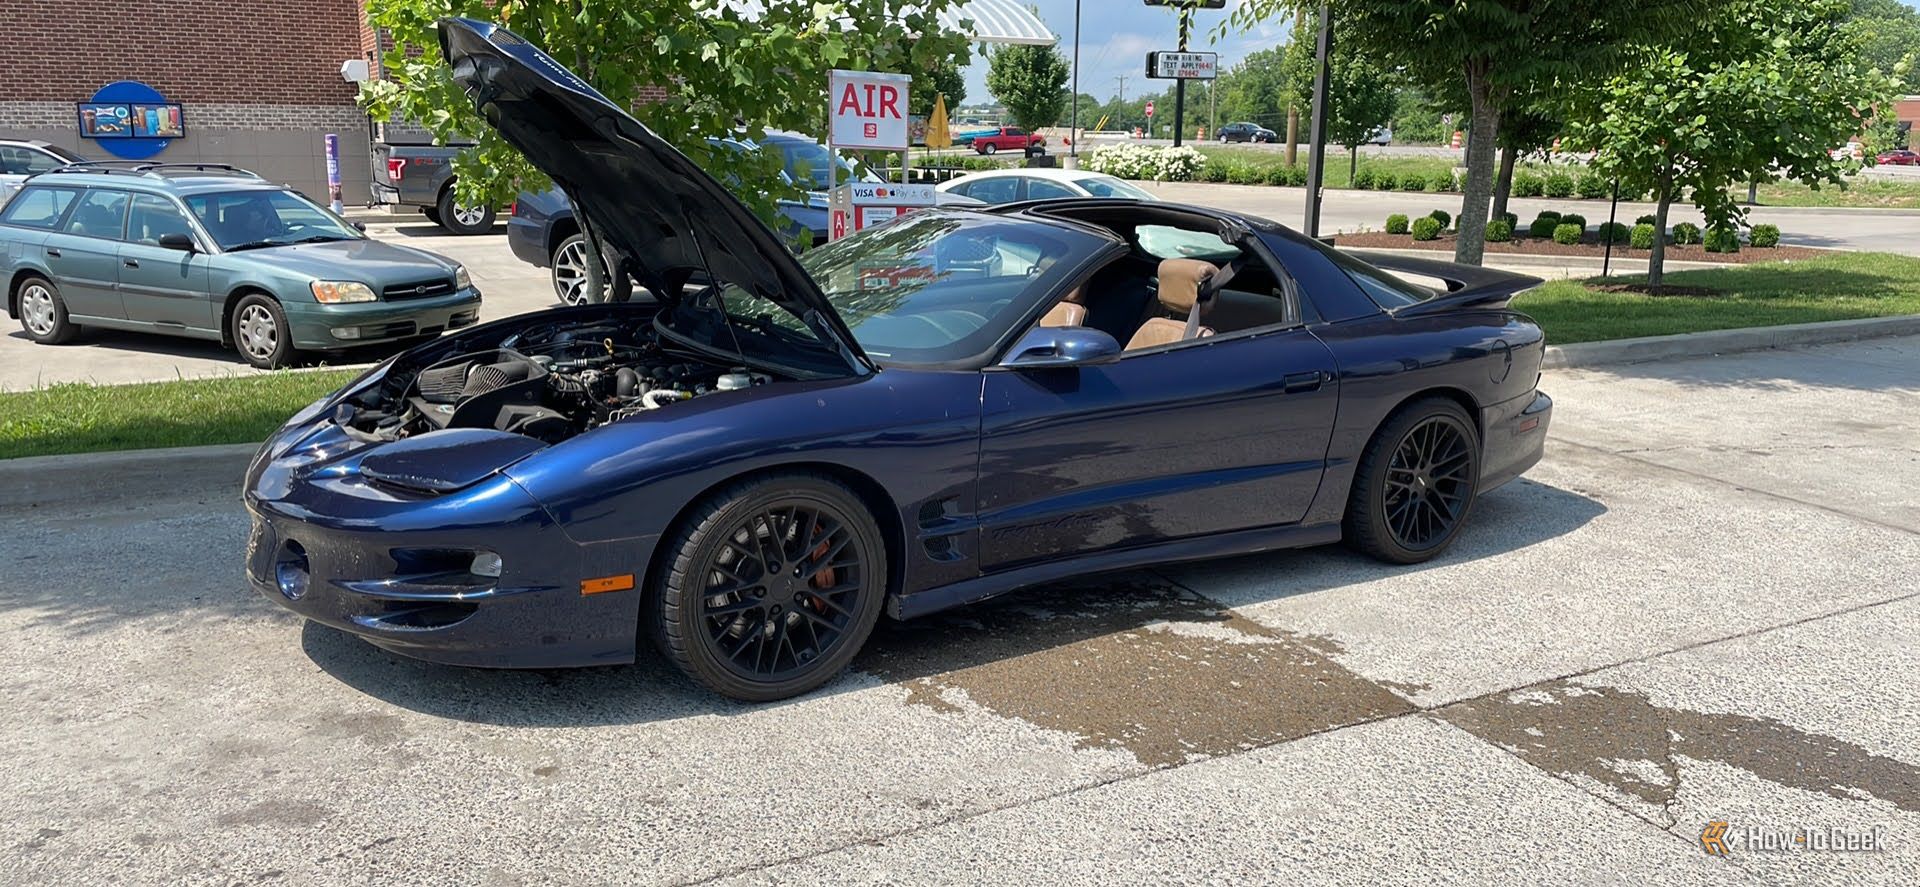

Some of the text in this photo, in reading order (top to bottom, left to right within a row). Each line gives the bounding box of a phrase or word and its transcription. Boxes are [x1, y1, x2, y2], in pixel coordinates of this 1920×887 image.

[1163, 61, 1177, 69] TEXT
[838, 83, 902, 119] AIR
[854, 189, 874, 198] VISA
